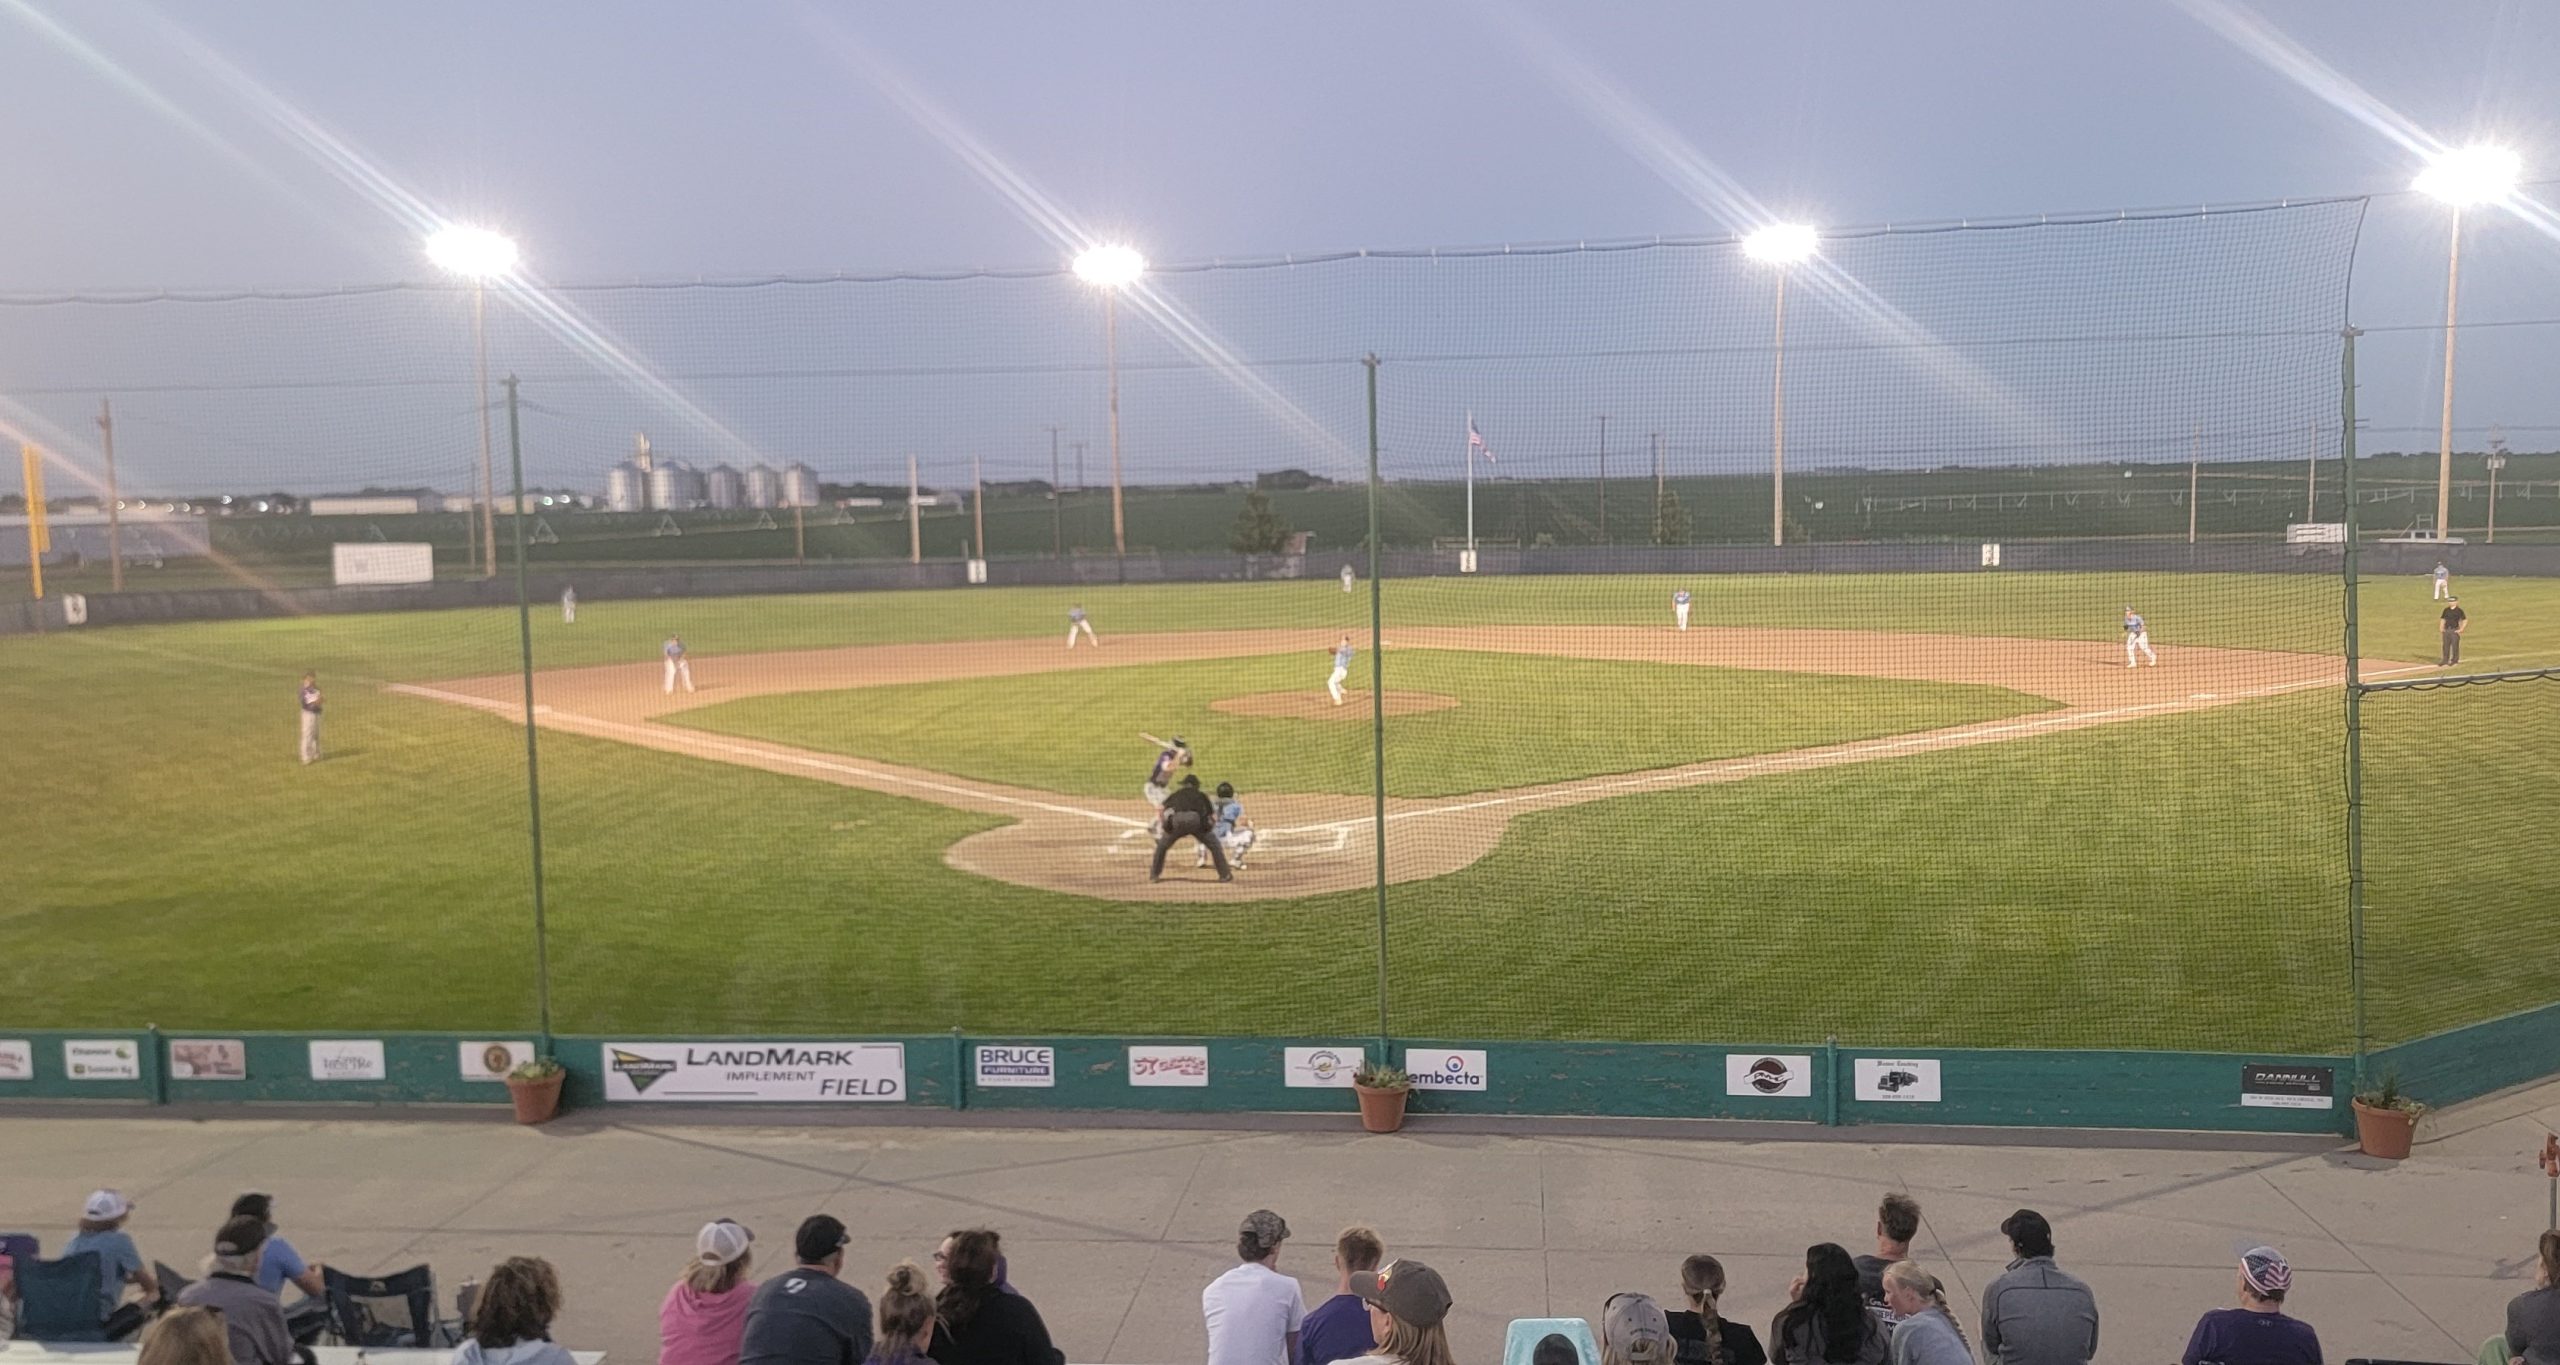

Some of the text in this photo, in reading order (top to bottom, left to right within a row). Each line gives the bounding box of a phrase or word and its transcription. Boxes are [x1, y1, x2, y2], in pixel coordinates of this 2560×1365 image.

[686, 1047, 853, 1066] LANDMARK
[980, 1049, 1051, 1064] BRUCE
[726, 1071, 816, 1081] IMPLEMENT
[983, 1066, 1047, 1075] FURNITURE
[1408, 1070, 1480, 1085] embecta
[820, 1078, 898, 1096] FIELD
